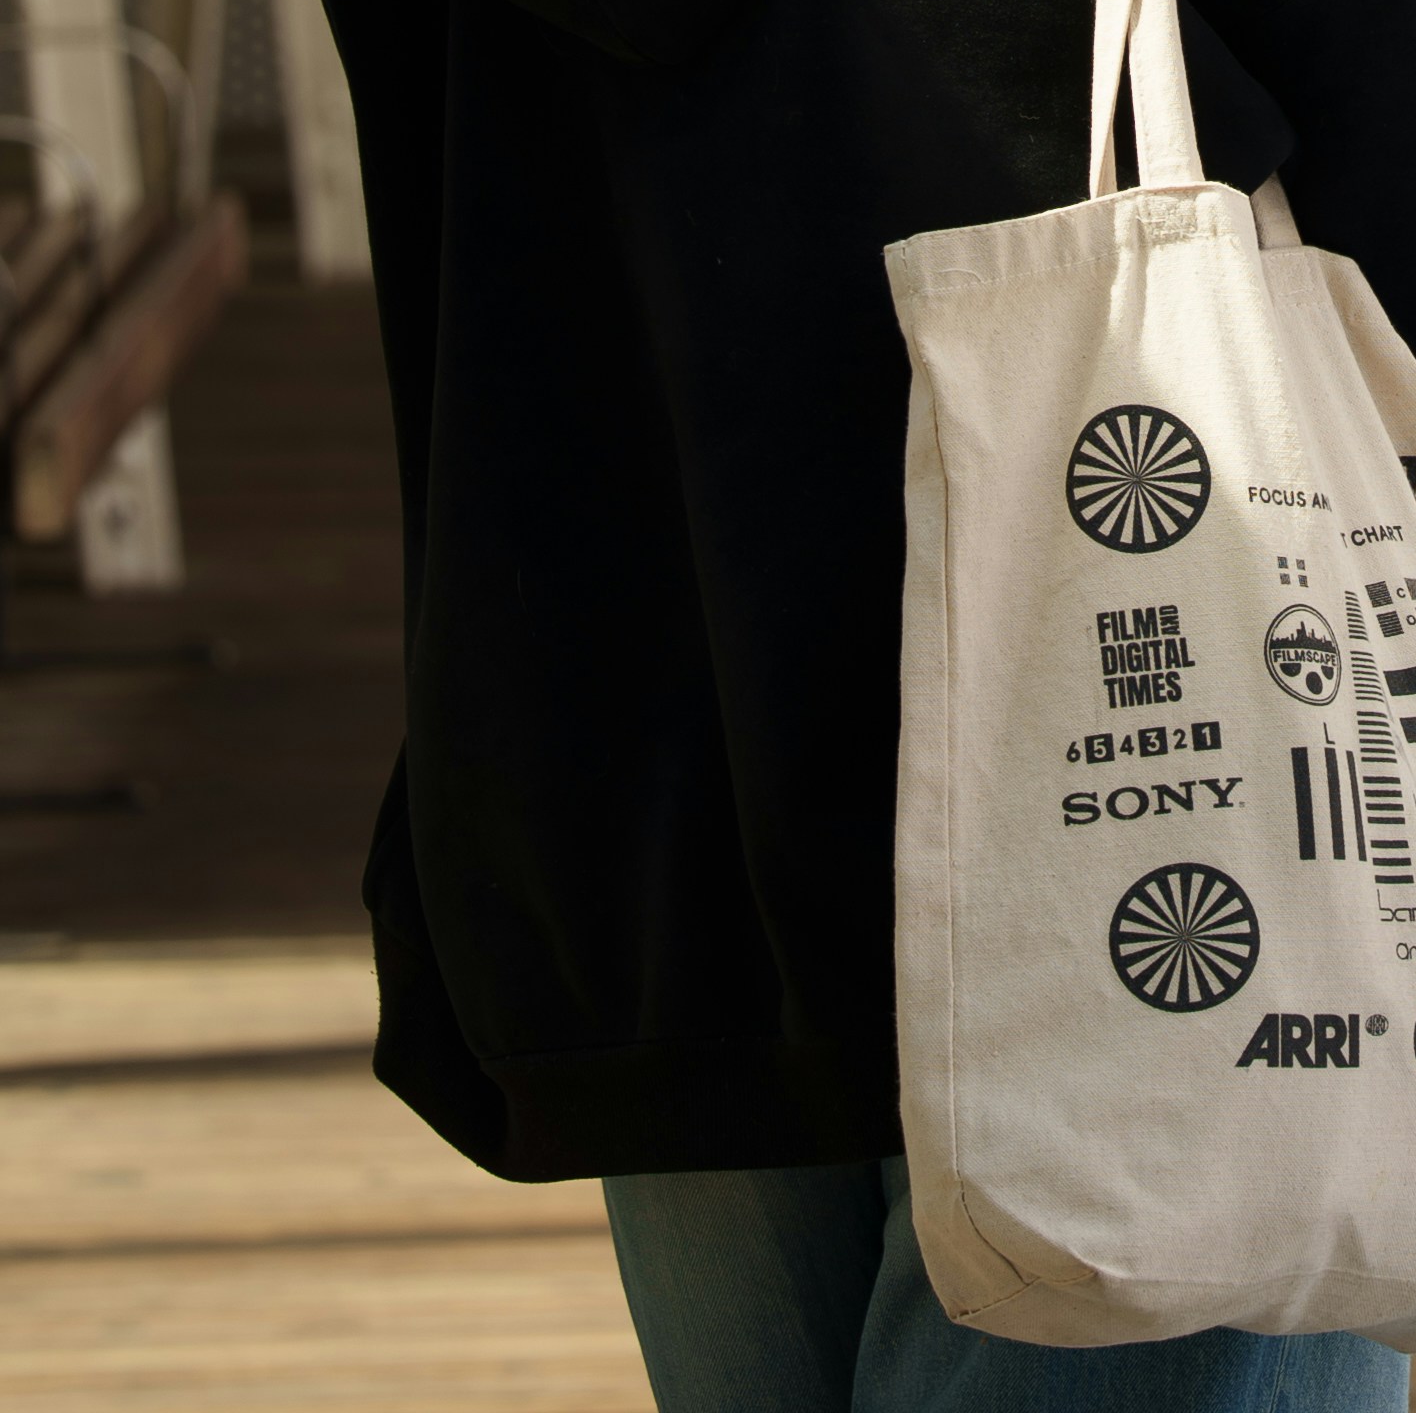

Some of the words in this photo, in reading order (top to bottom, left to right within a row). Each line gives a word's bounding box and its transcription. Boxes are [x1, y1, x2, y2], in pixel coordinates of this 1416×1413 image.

[1248, 486, 1307, 508] FOCUS
[1311, 491, 1333, 513] AN
[1350, 525, 1404, 547] CHART
[1396, 587, 1407, 599] C
[1096, 606, 1160, 644] FILM
[1159, 604, 1181, 636] AND
[1100, 637, 1196, 676] DIGITAL
[1272, 649, 1338, 667] FILMSCAPE
[1103, 670, 1183, 709] TIMES
[1061, 777, 1243, 827] SONY
[1235, 1013, 1360, 1069] ARRI
